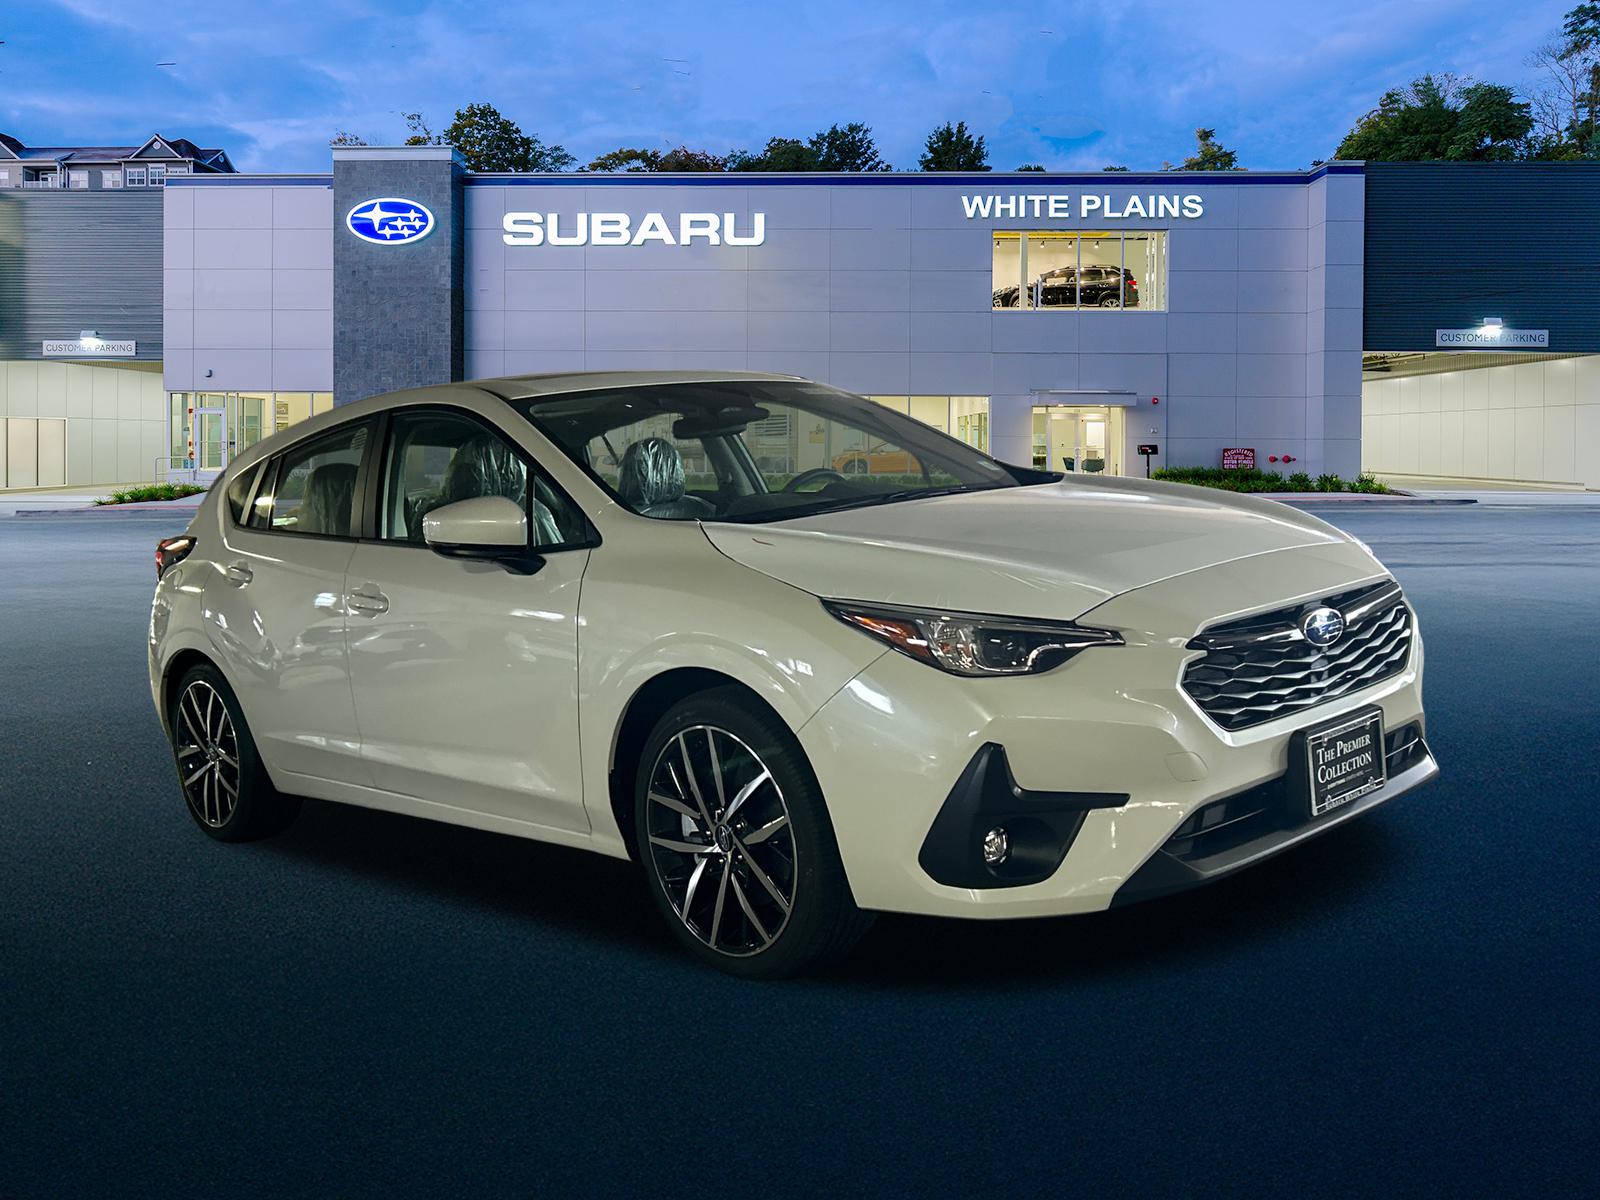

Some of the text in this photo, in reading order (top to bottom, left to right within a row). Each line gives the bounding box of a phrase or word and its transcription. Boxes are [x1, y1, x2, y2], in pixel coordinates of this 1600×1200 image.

[961, 194, 1204, 218] WHITE PLAINS
[502, 212, 766, 246] SUBARU
[45, 344, 133, 352] CUSTOMER PARKING
[1440, 333, 1545, 343] CUSTOMER PARKING
[1316, 735, 1371, 765] THE PREMIER
[1318, 752, 1372, 784] COLLECTION
